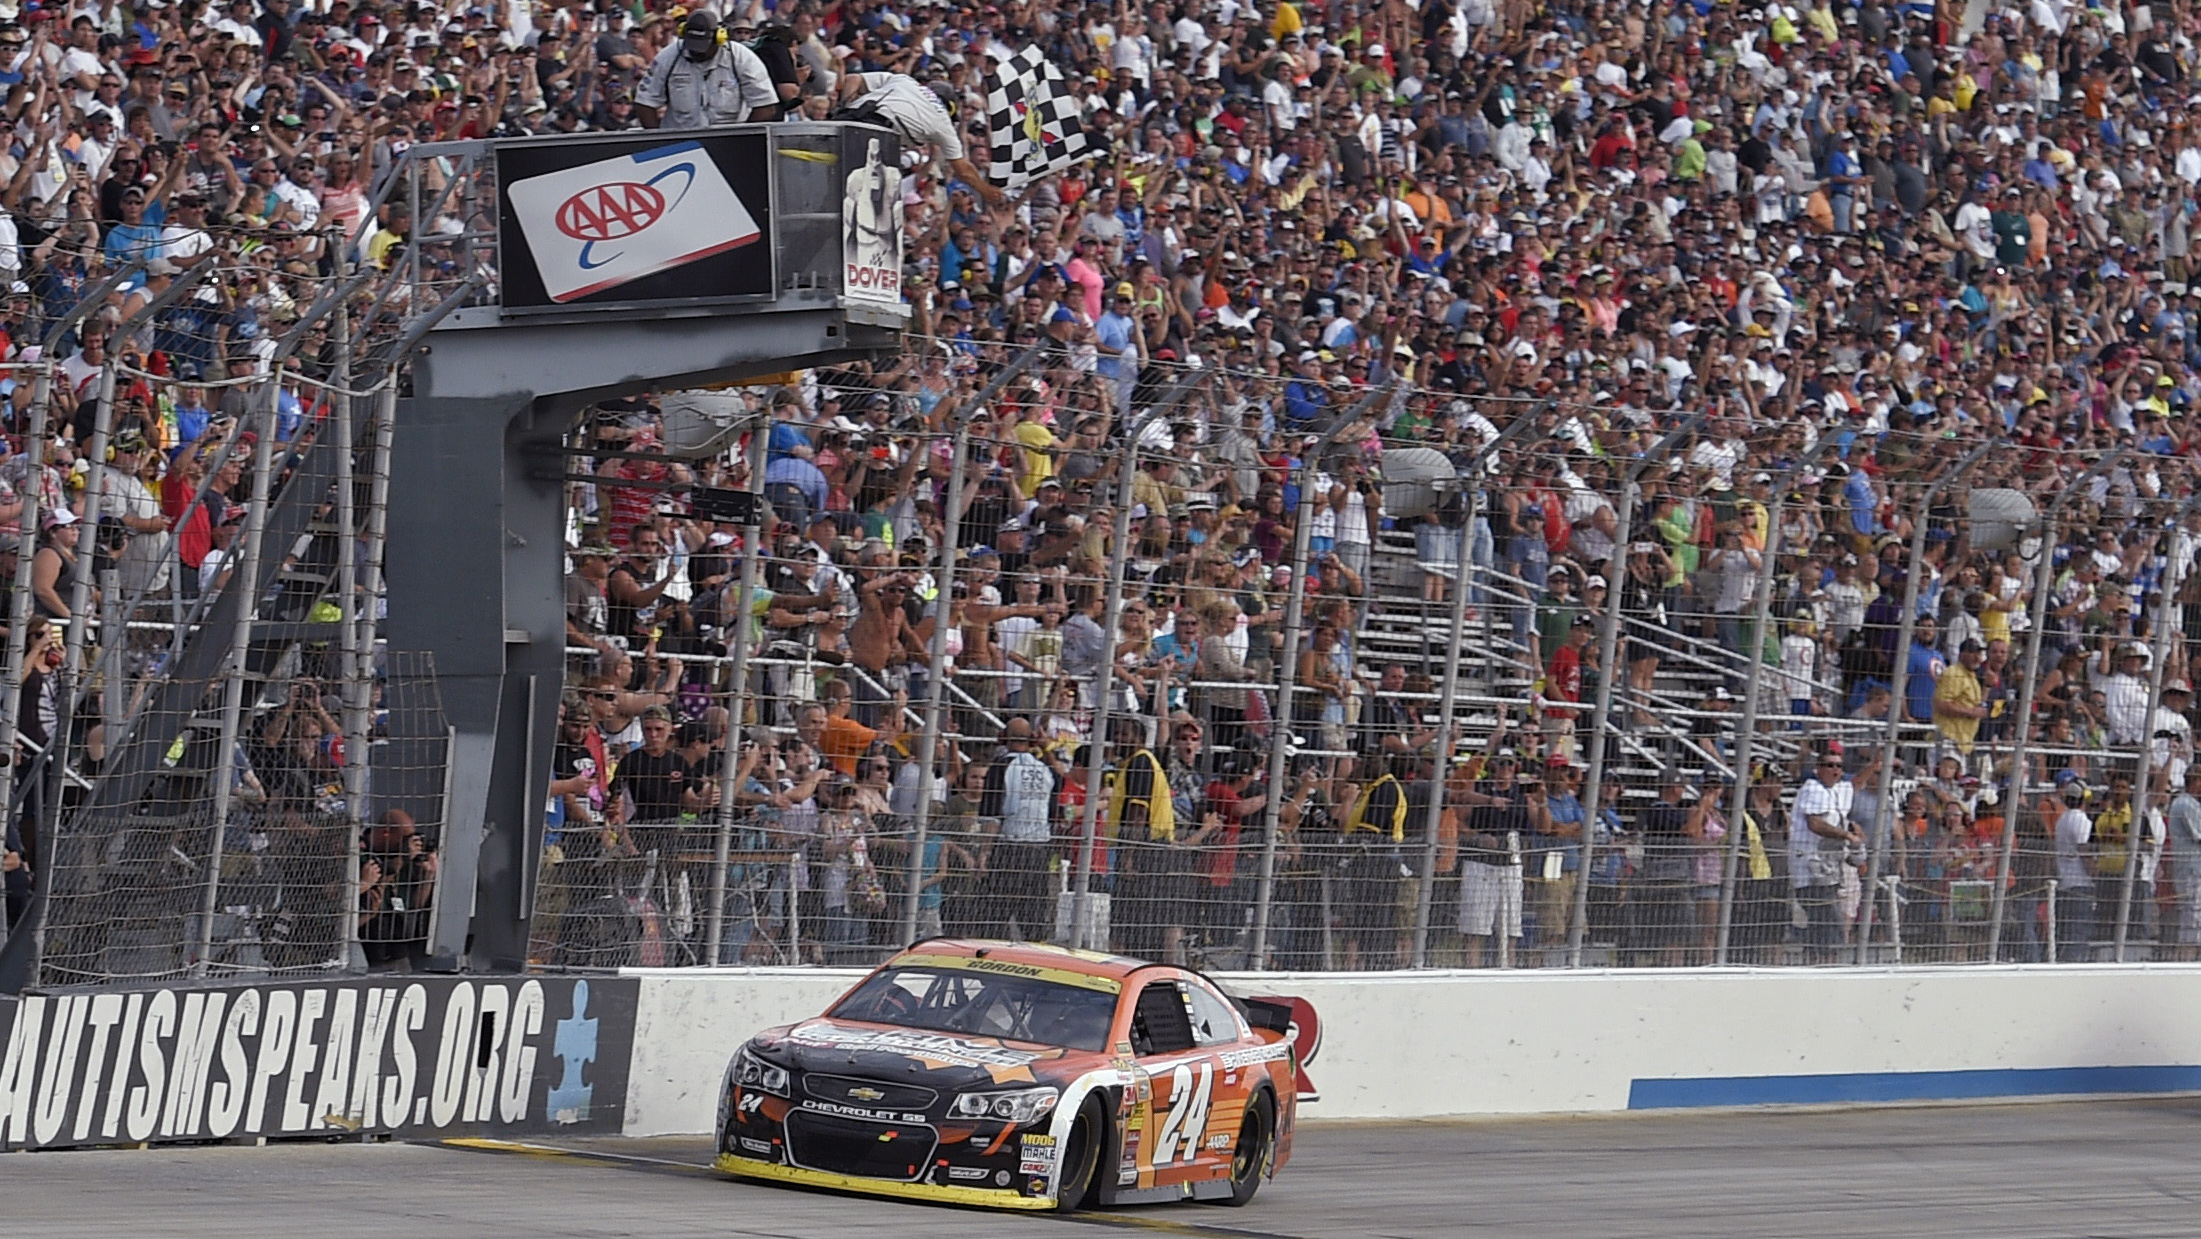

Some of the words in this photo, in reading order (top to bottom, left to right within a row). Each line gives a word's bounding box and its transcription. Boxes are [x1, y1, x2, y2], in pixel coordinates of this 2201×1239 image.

[566, 184, 658, 240] AAA
[848, 264, 898, 292] DOVER
[966, 960, 1043, 977] GORDON
[0, 979, 544, 1144] AUTISMSPEAKS.ORG
[738, 1093, 764, 1113] 24
[802, 1100, 897, 1120] CHEVROLET
[1153, 1062, 1214, 1165] 24
[1021, 1134, 1055, 1145] MOOG
[1022, 1148, 1055, 1159] MAHLE
